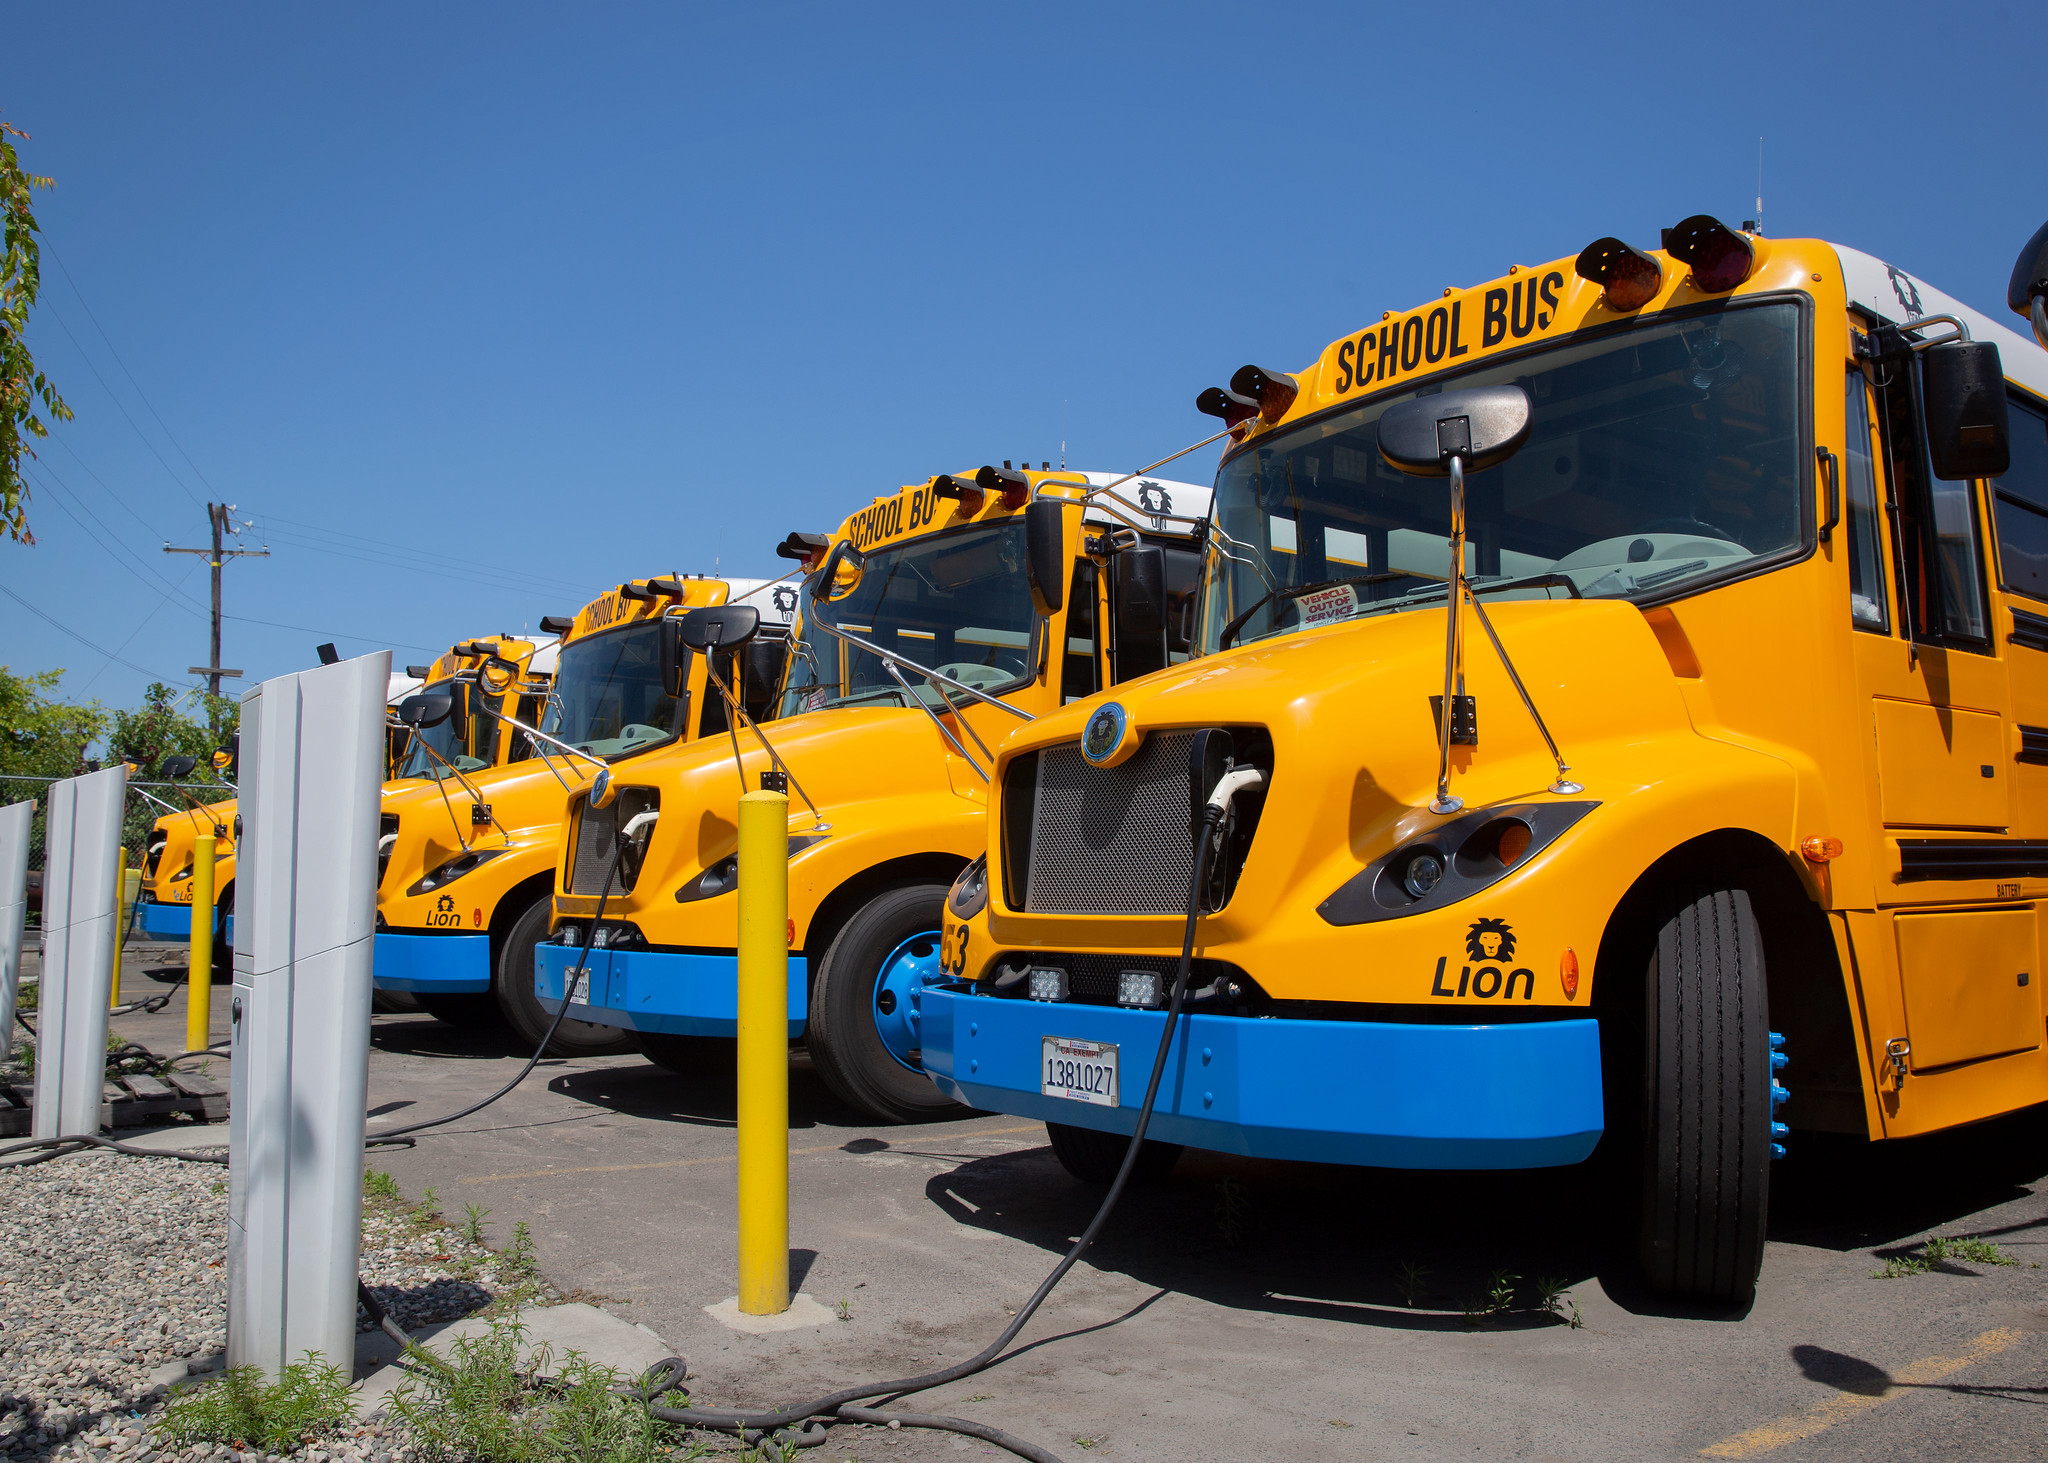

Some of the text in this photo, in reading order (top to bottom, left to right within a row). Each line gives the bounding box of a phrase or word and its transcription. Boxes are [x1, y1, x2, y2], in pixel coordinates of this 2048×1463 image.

[1336, 271, 1564, 395] SCHOOL BUS
[850, 487, 941, 550] SCHOOL BU
[1301, 587, 1350, 606] VEHICLE
[1308, 595, 1351, 614] OUT OF
[583, 594, 631, 633] SCHOOL BU
[1305, 604, 1354, 624] SERVICE
[1996, 883, 2021, 898] BATTERY
[425, 909, 461, 927] Lion
[941, 923, 970, 976] 53
[1431, 956, 1535, 1000] Lion
[1060, 1046, 1100, 1059] CA EXEMPT
[1046, 1058, 1113, 1096] 1381027
